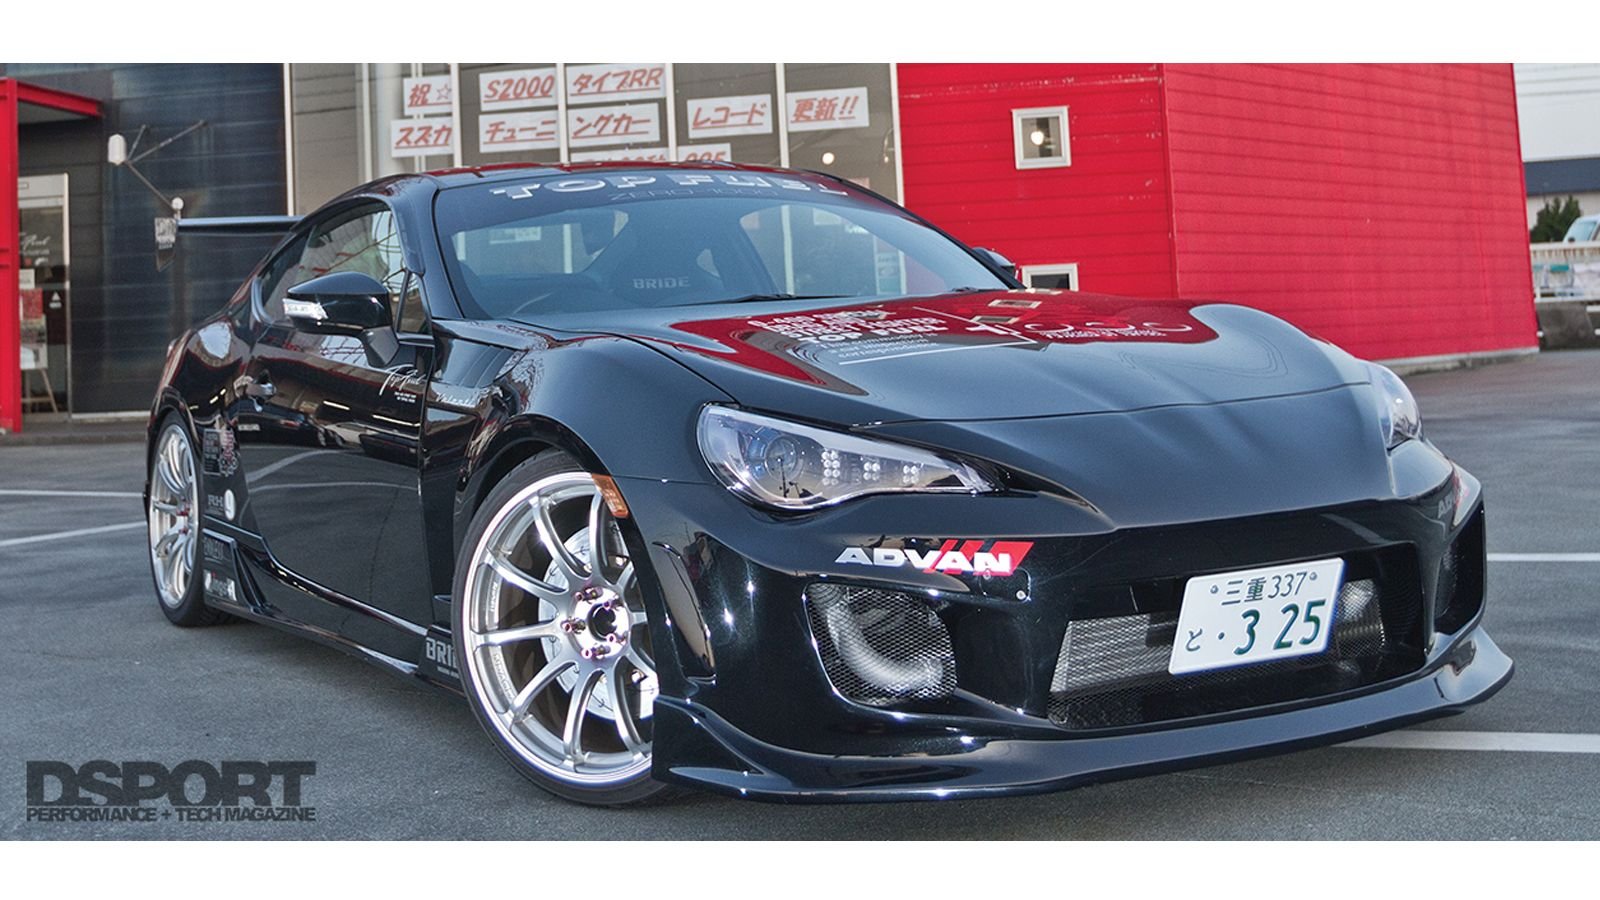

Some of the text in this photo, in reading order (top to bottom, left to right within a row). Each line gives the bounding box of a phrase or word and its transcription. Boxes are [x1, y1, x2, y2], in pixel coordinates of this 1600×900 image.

[484, 75, 555, 100] S2000
[693, 103, 767, 129] レコード
[396, 125, 452, 146] スズカ
[489, 174, 848, 200] TOP FUEL
[633, 276, 690, 289] BRIDE
[797, 332, 863, 343] TOP
[835, 547, 1011, 573] ADVAN
[1185, 628, 1203, 652] と
